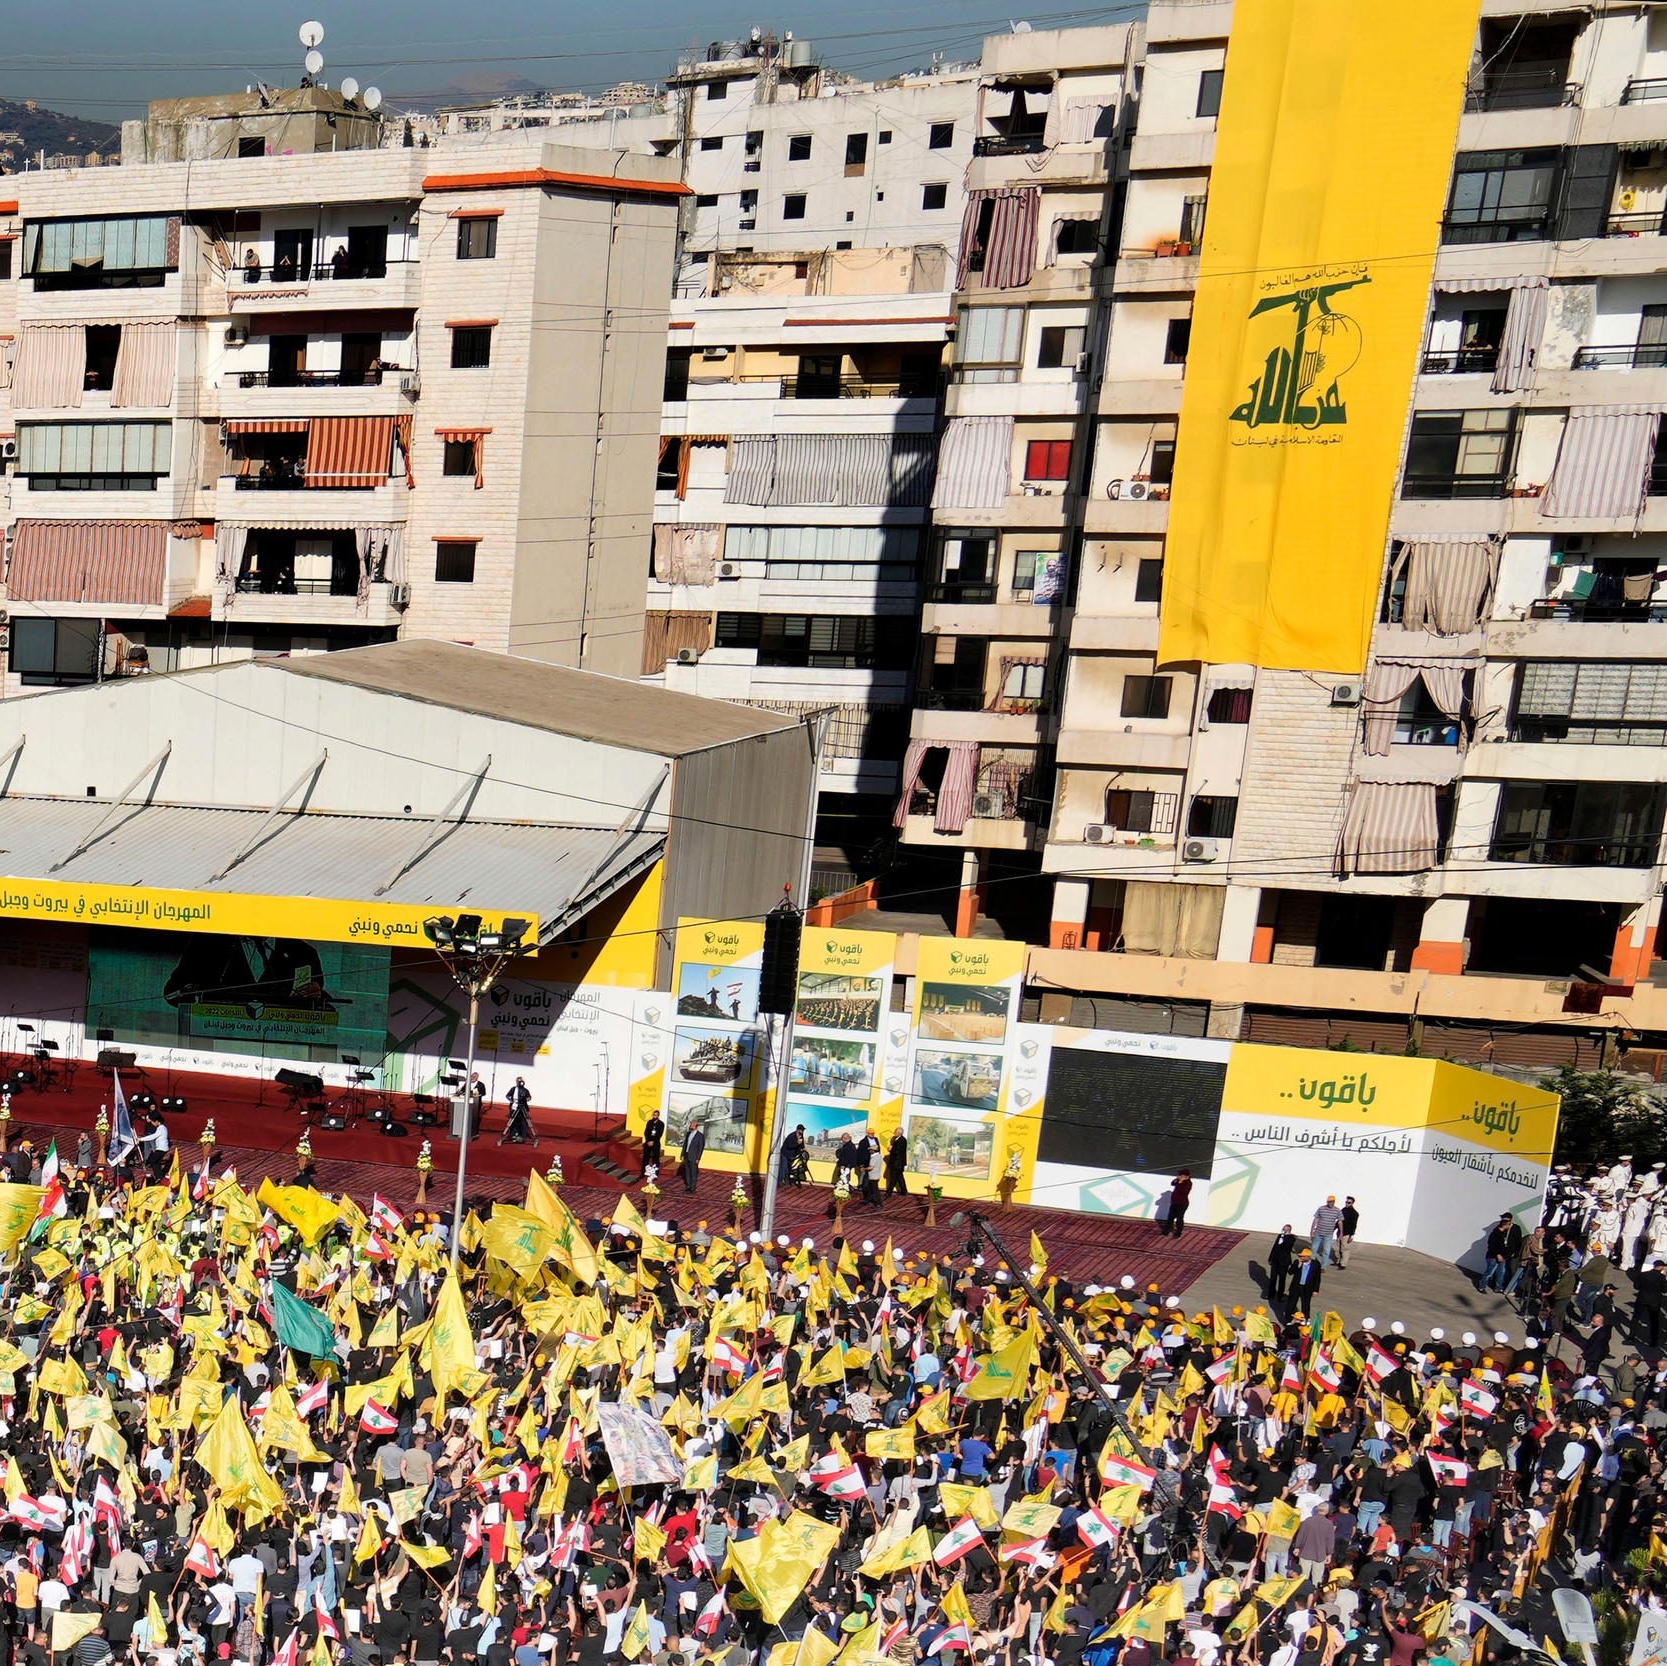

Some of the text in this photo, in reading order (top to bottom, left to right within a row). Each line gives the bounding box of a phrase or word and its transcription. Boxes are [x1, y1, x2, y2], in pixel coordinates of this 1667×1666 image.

[0, 891, 29, 910] وجبل
[33, 894, 68, 913] بيروت
[74, 895, 85, 917] في
[90, 897, 148, 921] الإنتخابي
[154, 901, 211, 922] المهرجان
[349, 917, 418, 939] نحمي ونبني
[717, 934, 739, 946] باقون
[839, 943, 862, 955] باقون
[719, 947, 736, 956] نحمي
[965, 954, 988, 966] باقون
[841, 957, 859, 966] نحمي
[966, 967, 986, 976] نحمي
[513, 990, 552, 1012] باقون
[490, 1012, 550, 1031] نحمي ونبني
[1244, 1125, 1412, 1154] لأجلكم يا أشرف الناس
[1432, 1144, 1538, 1190] لنخدمكم بأشفار العيون
